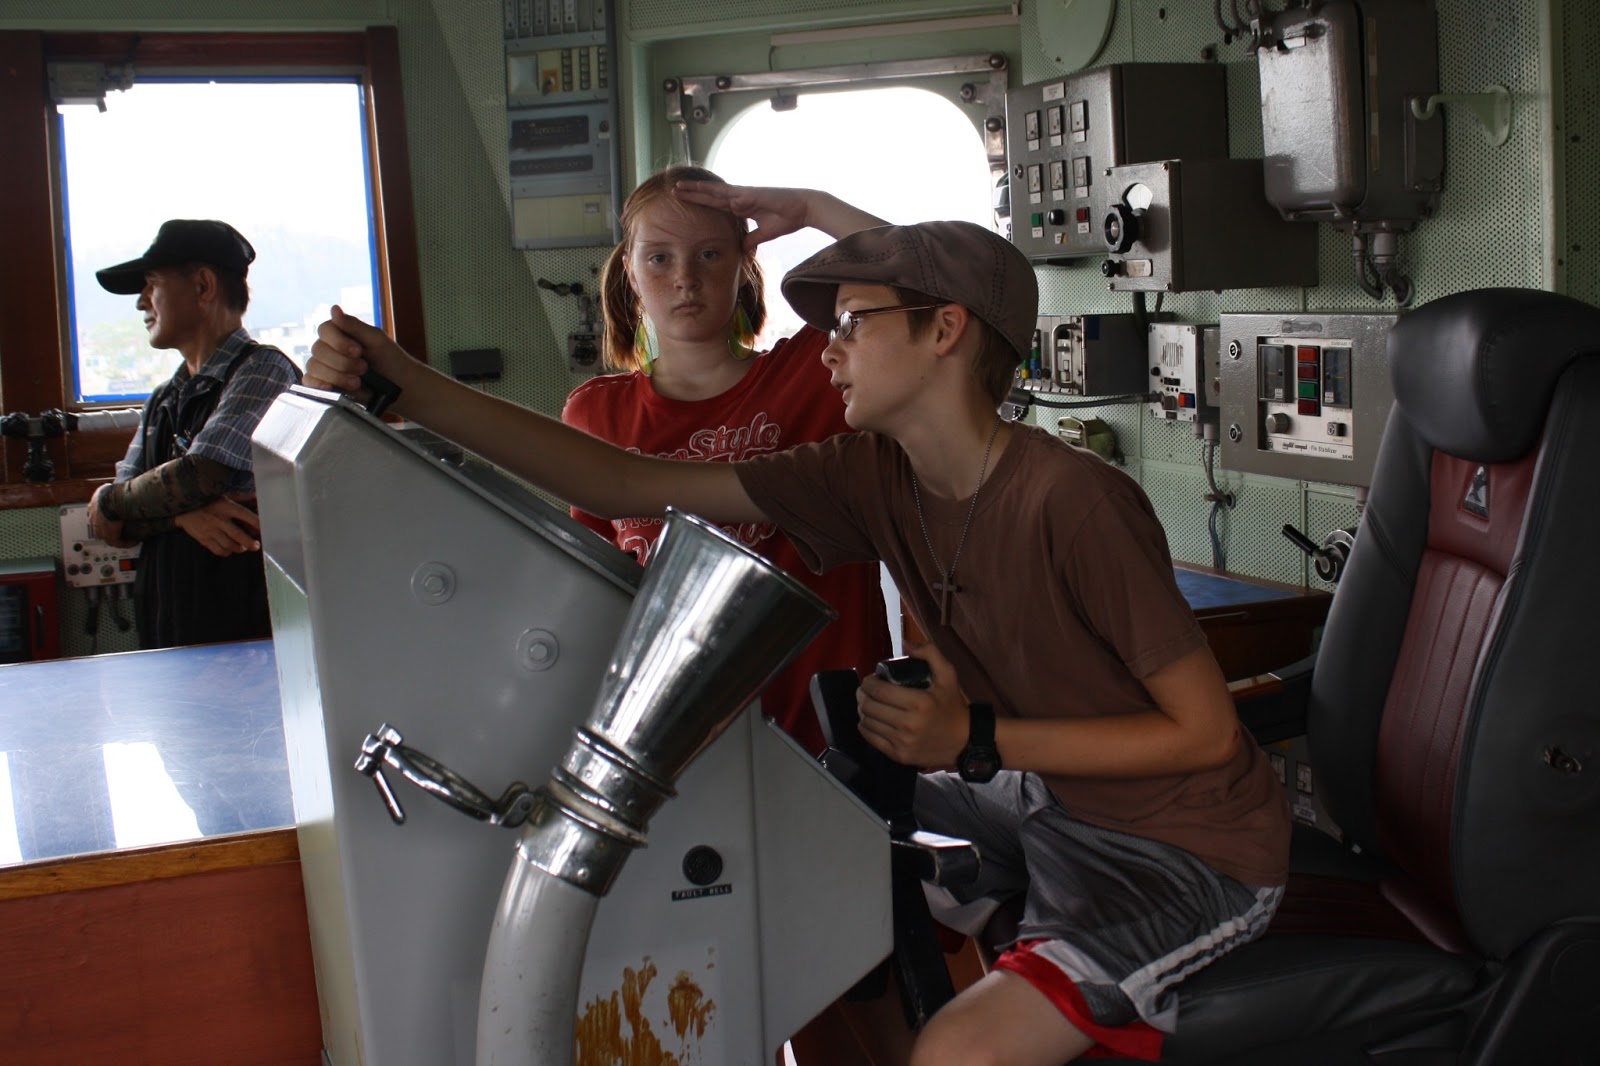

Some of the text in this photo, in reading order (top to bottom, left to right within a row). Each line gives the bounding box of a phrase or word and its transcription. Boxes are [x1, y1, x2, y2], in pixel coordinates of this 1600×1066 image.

[689, 411, 781, 463] Style
[1318, 446, 1337, 454] Stabilizer
[675, 885, 729, 898] FAULT BELL
